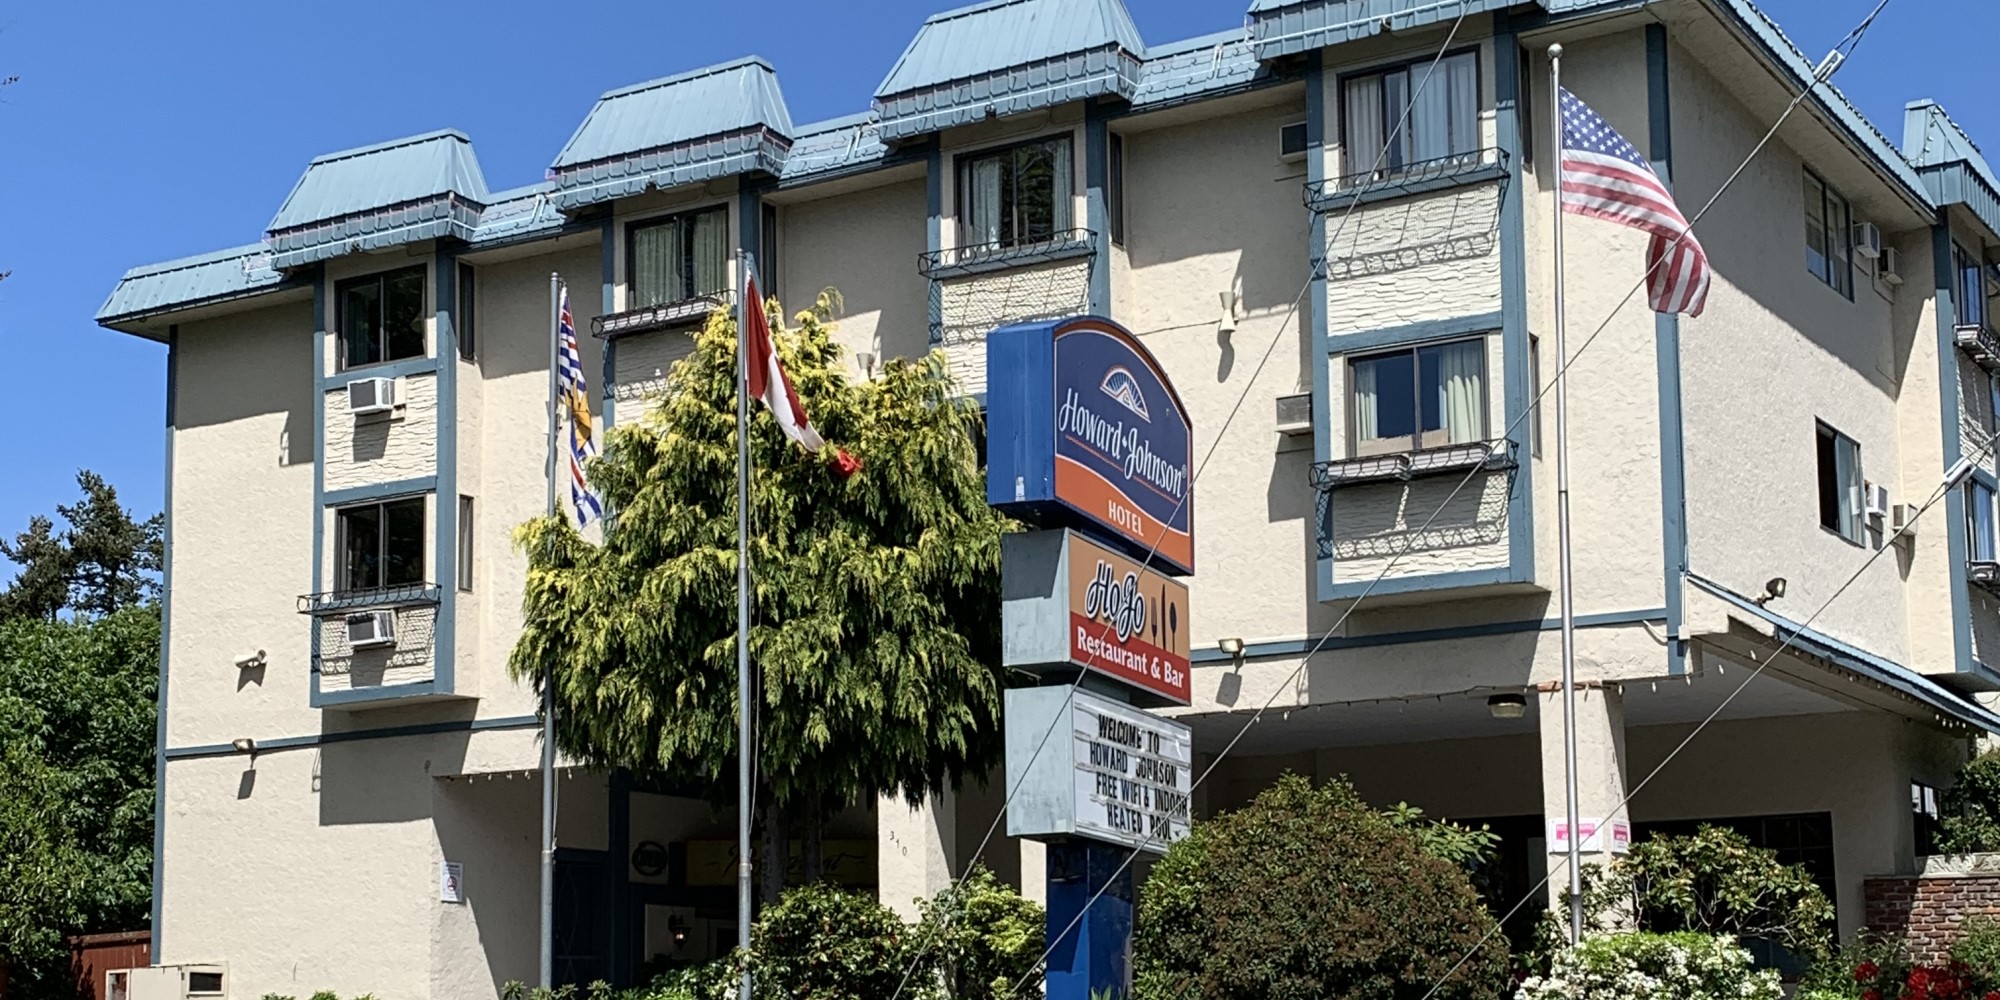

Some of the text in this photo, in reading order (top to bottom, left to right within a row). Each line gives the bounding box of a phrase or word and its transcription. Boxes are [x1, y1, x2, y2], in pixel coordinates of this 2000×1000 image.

[1058, 387, 1122, 460] Howard
[1108, 500, 1144, 536] HOTEL
[1085, 559, 1146, 642] HoJo
[1077, 625, 1184, 688] Restaurant & Bar
[1098, 714, 1160, 755] WELCOME TO
[1089, 741, 1177, 788] HOWARD JOHNSON
[1096, 772, 1188, 817] FREE WIFI & INDOOR
[889, 830, 908, 857] 310
[1106, 803, 1172, 840] HEATED POOL
